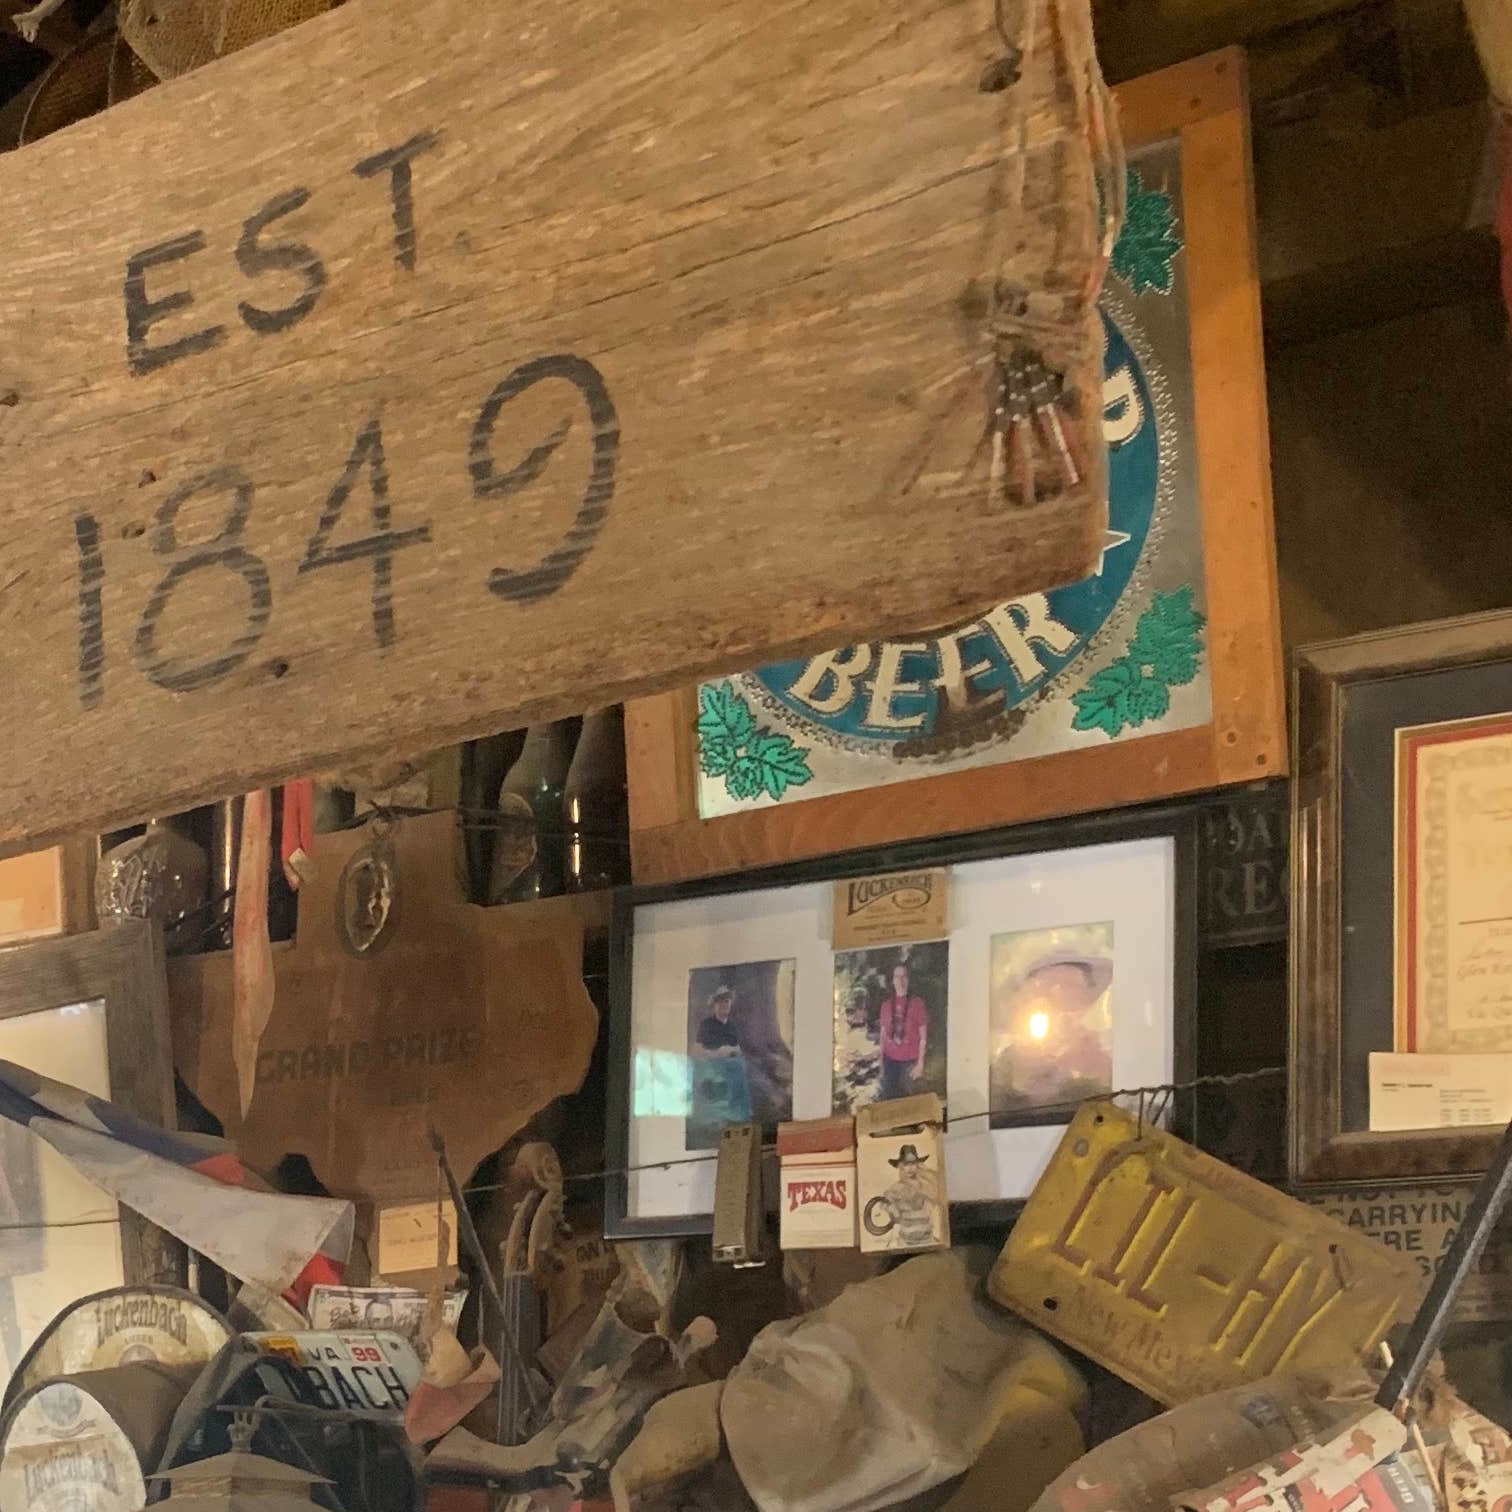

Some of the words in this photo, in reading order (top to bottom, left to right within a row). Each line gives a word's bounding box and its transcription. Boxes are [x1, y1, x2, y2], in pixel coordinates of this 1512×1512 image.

[74, 353, 620, 711] 1849
[786, 592, 1082, 732] BEER
[787, 1180, 847, 1212] TEXAS
[352, 1347, 381, 1362] 99
